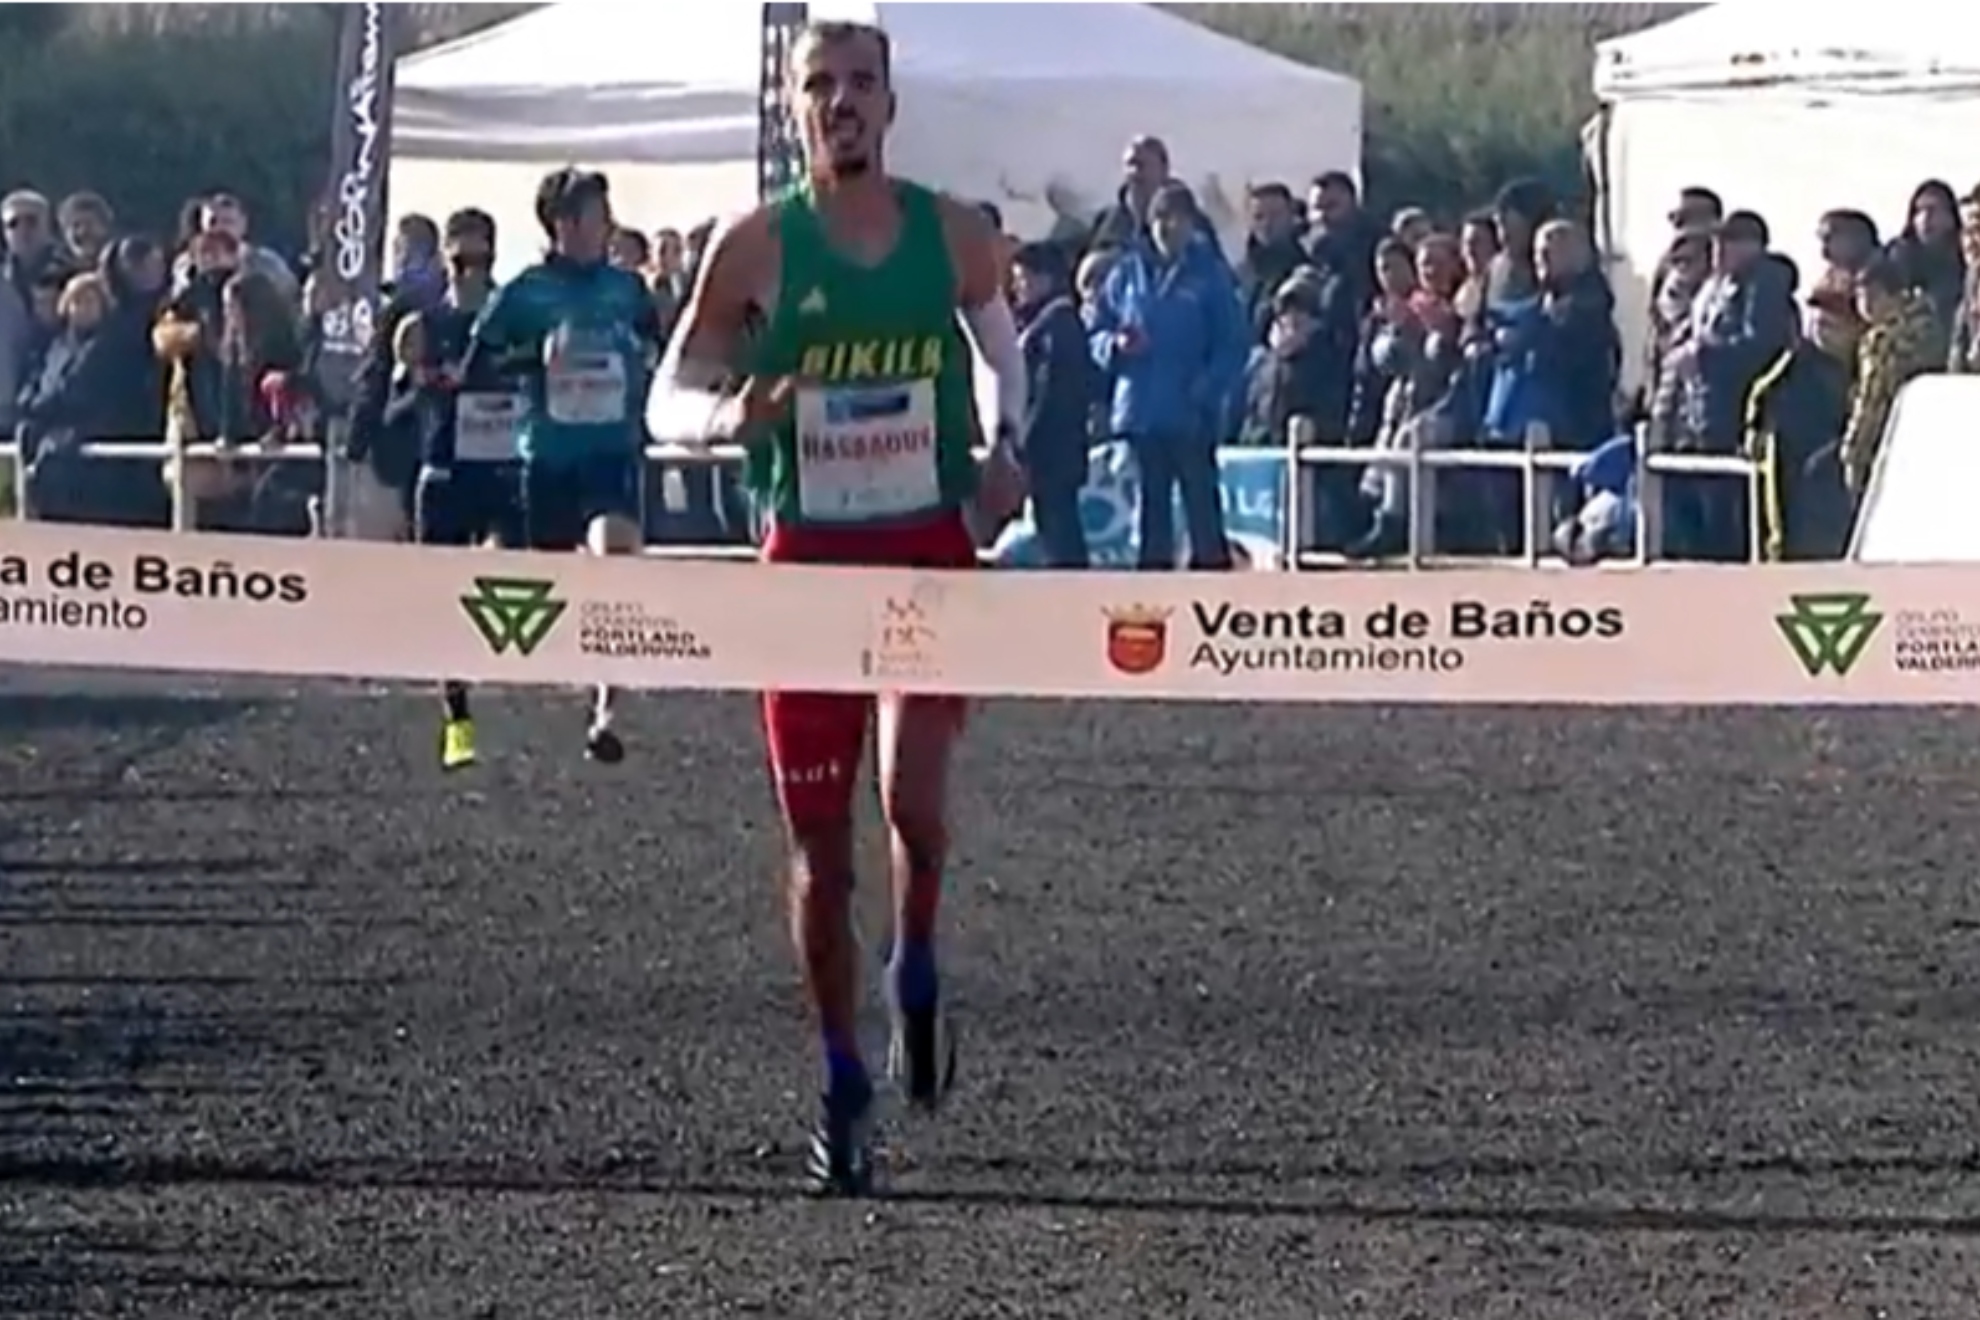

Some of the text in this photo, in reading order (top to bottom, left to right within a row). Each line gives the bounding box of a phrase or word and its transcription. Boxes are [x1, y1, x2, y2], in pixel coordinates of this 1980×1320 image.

[49, 551, 112, 589] de
[134, 555, 307, 601] Baños
[1192, 600, 1624, 638] Venta de Baños
[1190, 642, 1464, 676] Ayuntamiento
